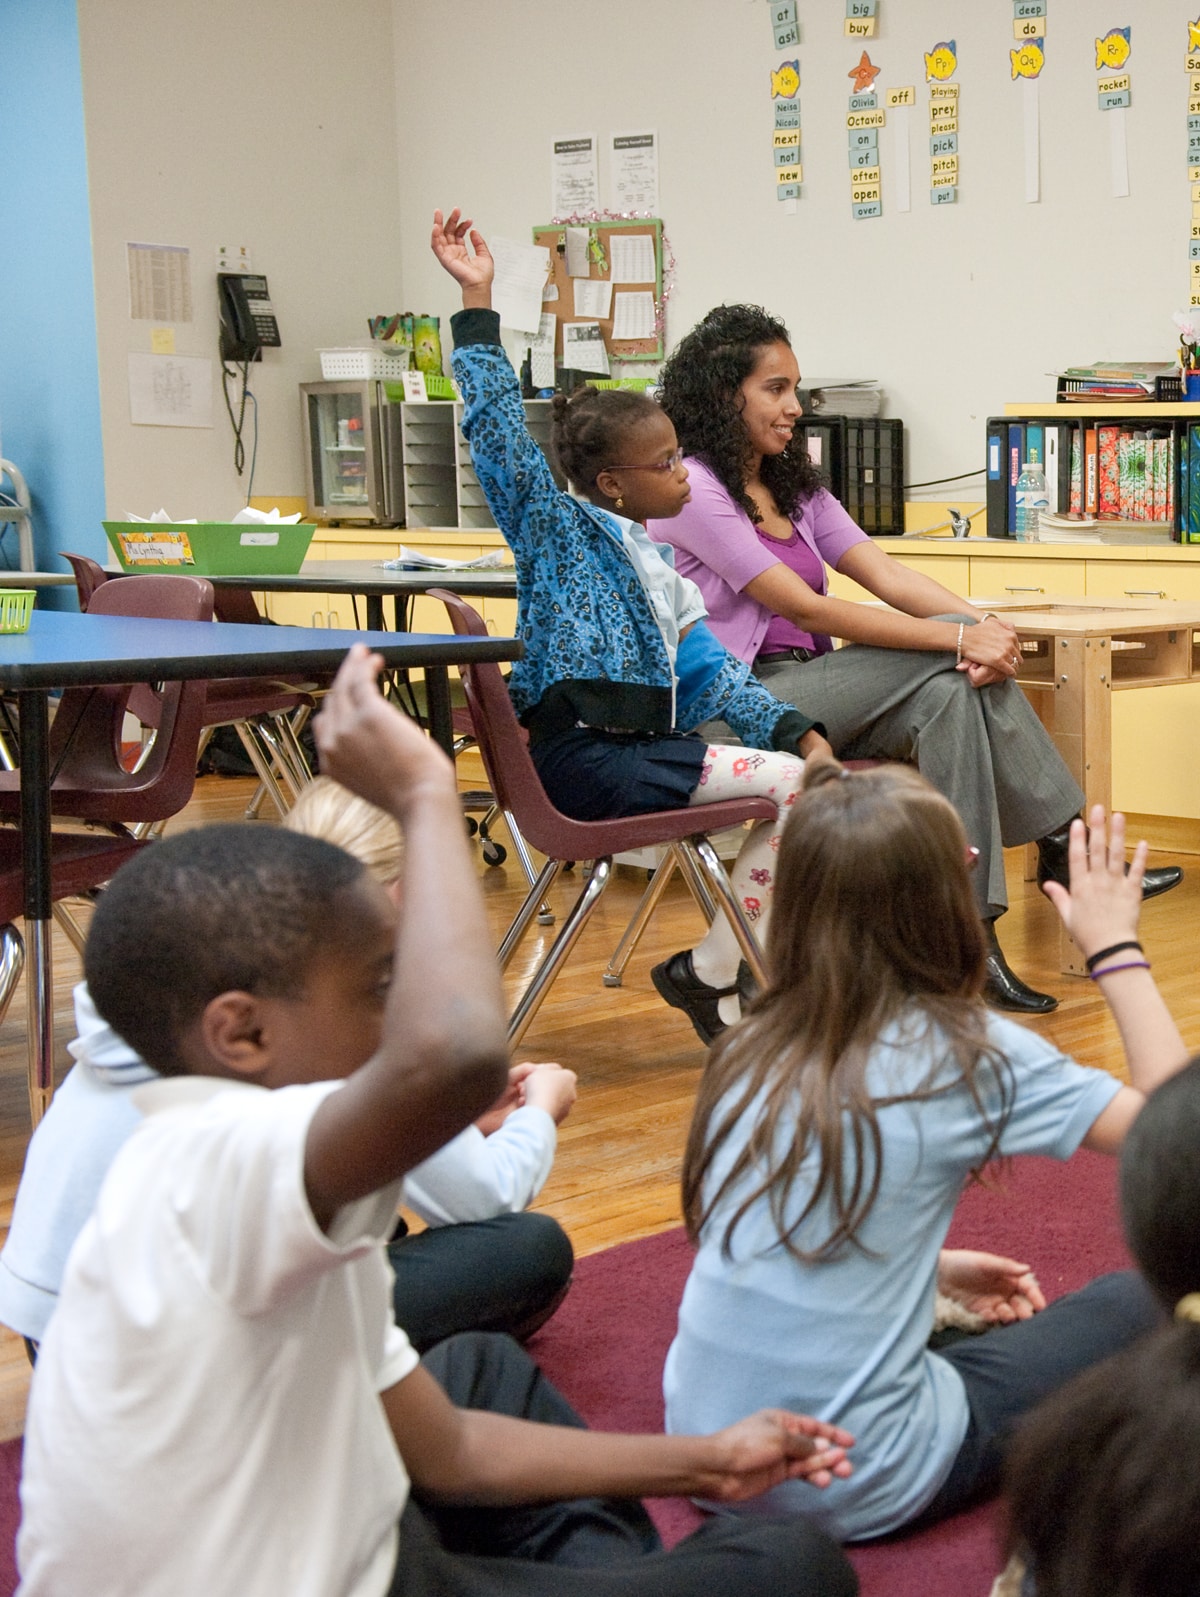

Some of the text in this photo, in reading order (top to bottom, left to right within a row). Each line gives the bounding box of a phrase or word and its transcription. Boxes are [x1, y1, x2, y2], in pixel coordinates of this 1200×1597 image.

[777, 9, 789, 21] at
[853, 4, 869, 16] big
[1019, 6, 1041, 16] deep
[850, 22, 869, 36] buy
[1023, 23, 1036, 34] do
[779, 29, 796, 44] ask
[1108, 44, 1118, 55] Rr
[1020, 55, 1036, 68] Qq
[1099, 79, 1127, 91] rocket
[892, 92, 909, 104] off
[932, 88, 957, 97] playing
[852, 98, 874, 107] Olivia
[1107, 97, 1122, 105] run
[932, 104, 955, 119] prey
[848, 114, 882, 126] Octavio
[932, 123, 955, 133] please
[775, 135, 798, 144] next
[858, 135, 869, 144] on
[933, 140, 953, 152] pick
[780, 153, 795, 163] not
[858, 153, 869, 164] of
[933, 158, 955, 171] pitch
[780, 171, 798, 180] new
[853, 171, 878, 181] often
[854, 190, 877, 202] open
[938, 192, 950, 202] put
[858, 207, 877, 215] over
